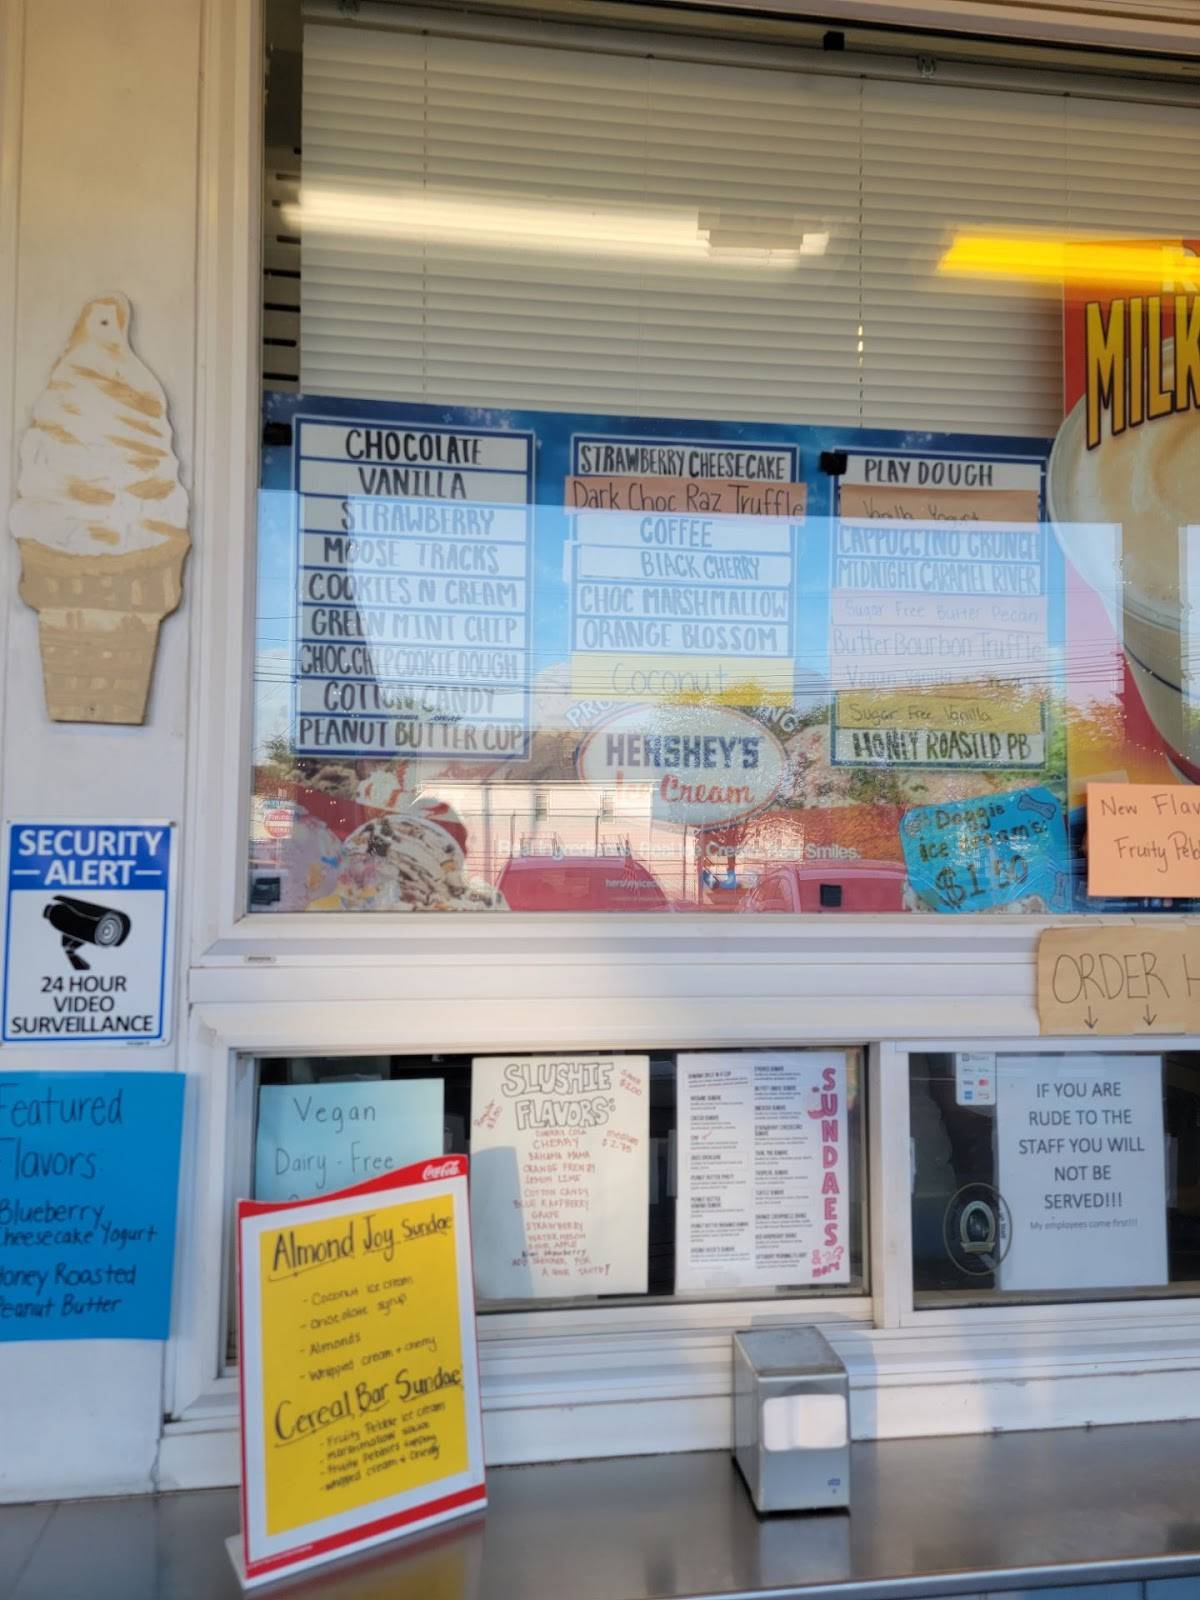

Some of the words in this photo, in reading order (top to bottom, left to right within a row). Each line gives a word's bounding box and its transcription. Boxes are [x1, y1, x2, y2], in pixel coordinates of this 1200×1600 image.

[346, 429, 482, 465] CHOCOLATE
[581, 445, 684, 476] STRAWBERRY
[689, 452, 786, 479] CHEESECAKE
[358, 467, 466, 499] VANILLA
[865, 458, 911, 484] PLAY
[918, 461, 993, 486] DOUGH
[573, 480, 622, 510] Dark
[628, 482, 677, 512] Choc
[686, 483, 722, 512] Raz
[728, 484, 804, 516] Truffle
[341, 501, 495, 536] STRAWBERRY
[640, 516, 713, 548] COFFEE
[324, 537, 399, 566] MOOSE
[417, 542, 500, 574] TRACKS
[839, 525, 961, 557] CAPPUCCINO
[970, 531, 1039, 559] CRUNCH
[641, 551, 701, 578] BLACK
[703, 555, 760, 581] CHERRY
[840, 561, 916, 589] MIDNIGHT
[920, 563, 986, 592] CARAMEL
[992, 565, 1037, 594] RIVER
[309, 573, 411, 604] COOKIES
[419, 578, 436, 602] N
[445, 578, 517, 608] CREAM
[581, 585, 634, 614] CHOC
[643, 588, 786, 618] MARSHMALLOW
[312, 609, 387, 639] GREEN
[393, 611, 456, 642] MINT
[464, 616, 517, 643] CHIP
[895, 602, 926, 618] Free
[583, 619, 673, 648] ORANGE
[682, 624, 778, 651] BLOSSOM
[833, 629, 893, 656] Butter
[895, 632, 972, 657] Bourbon
[980, 633, 1042, 660] Truffle
[302, 644, 350, 674] CHOC
[393, 647, 455, 678] COOKIE
[458, 649, 518, 681] DOUGH
[611, 662, 725, 693] Coconut
[325, 681, 414, 712] COTTON
[422, 686, 494, 715] CANDY
[850, 703, 897, 722] Sugar
[908, 705, 932, 720] Free
[944, 705, 991, 723] Vanilla
[301, 718, 388, 746] PEANUT
[395, 720, 475, 750] BUTTER
[484, 724, 522, 751] CUP
[926, 733, 1001, 760] ROASTED
[1007, 733, 1032, 760] PB
[606, 733, 760, 769] HERSHEY'S
[660, 773, 753, 806] Cream
[935, 802, 1005, 832] Doggie
[1101, 796, 1138, 816] New
[18, 829, 164, 857] SECURITY
[1113, 836, 1168, 873] Fruity
[44, 859, 136, 886] ALERT
[40, 976, 64, 993] 24
[69, 976, 127, 992] HOUR
[1052, 952, 1170, 1004] ORDER
[53, 996, 115, 1013] VIDEO
[11, 1015, 153, 1034] SURVEILLANCE
[502, 1062, 614, 1097] SLUSHIE
[1036, 1083, 1050, 1098] IF
[1053, 1082, 1087, 1098] YOU
[1091, 1081, 1122, 1098] ARE
[293, 1096, 376, 1134] Vegan
[515, 1096, 616, 1130] FLAVORS:
[1029, 1110, 1071, 1126] RUDE
[1076, 1110, 1097, 1125] TO
[1103, 1109, 1132, 1125] THE
[820, 1067, 840, 1247] SUNDAES
[1019, 1138, 1064, 1155] STAFF
[1068, 1138, 1102, 1153] YOU
[1107, 1136, 1145, 1152] WILL
[275, 1148, 327, 1189] Dairy
[350, 1141, 394, 1173] Free
[422, 1160, 460, 1182] Coca-Cola
[1054, 1166, 1086, 1181] NOT
[1092, 1165, 1111, 1180] BE
[1044, 1191, 1123, 1209] SERVED!!!
[101, 1220, 158, 1250] Yogurt
[1030, 1221, 1043, 1231] My
[1045, 1219, 1087, 1231] employees
[1089, 1220, 1110, 1230] come
[273, 1221, 354, 1271] Almond
[363, 1215, 395, 1263] Joy
[402, 1213, 453, 1240] Sundae
[54, 1262, 137, 1287] Roasted
[61, 1293, 123, 1317] Butter
[309, 1332, 361, 1356] Almonds
[274, 1392, 352, 1442] Cereal
[356, 1381, 389, 1411] Bar
[395, 1364, 461, 1402] Sundae
